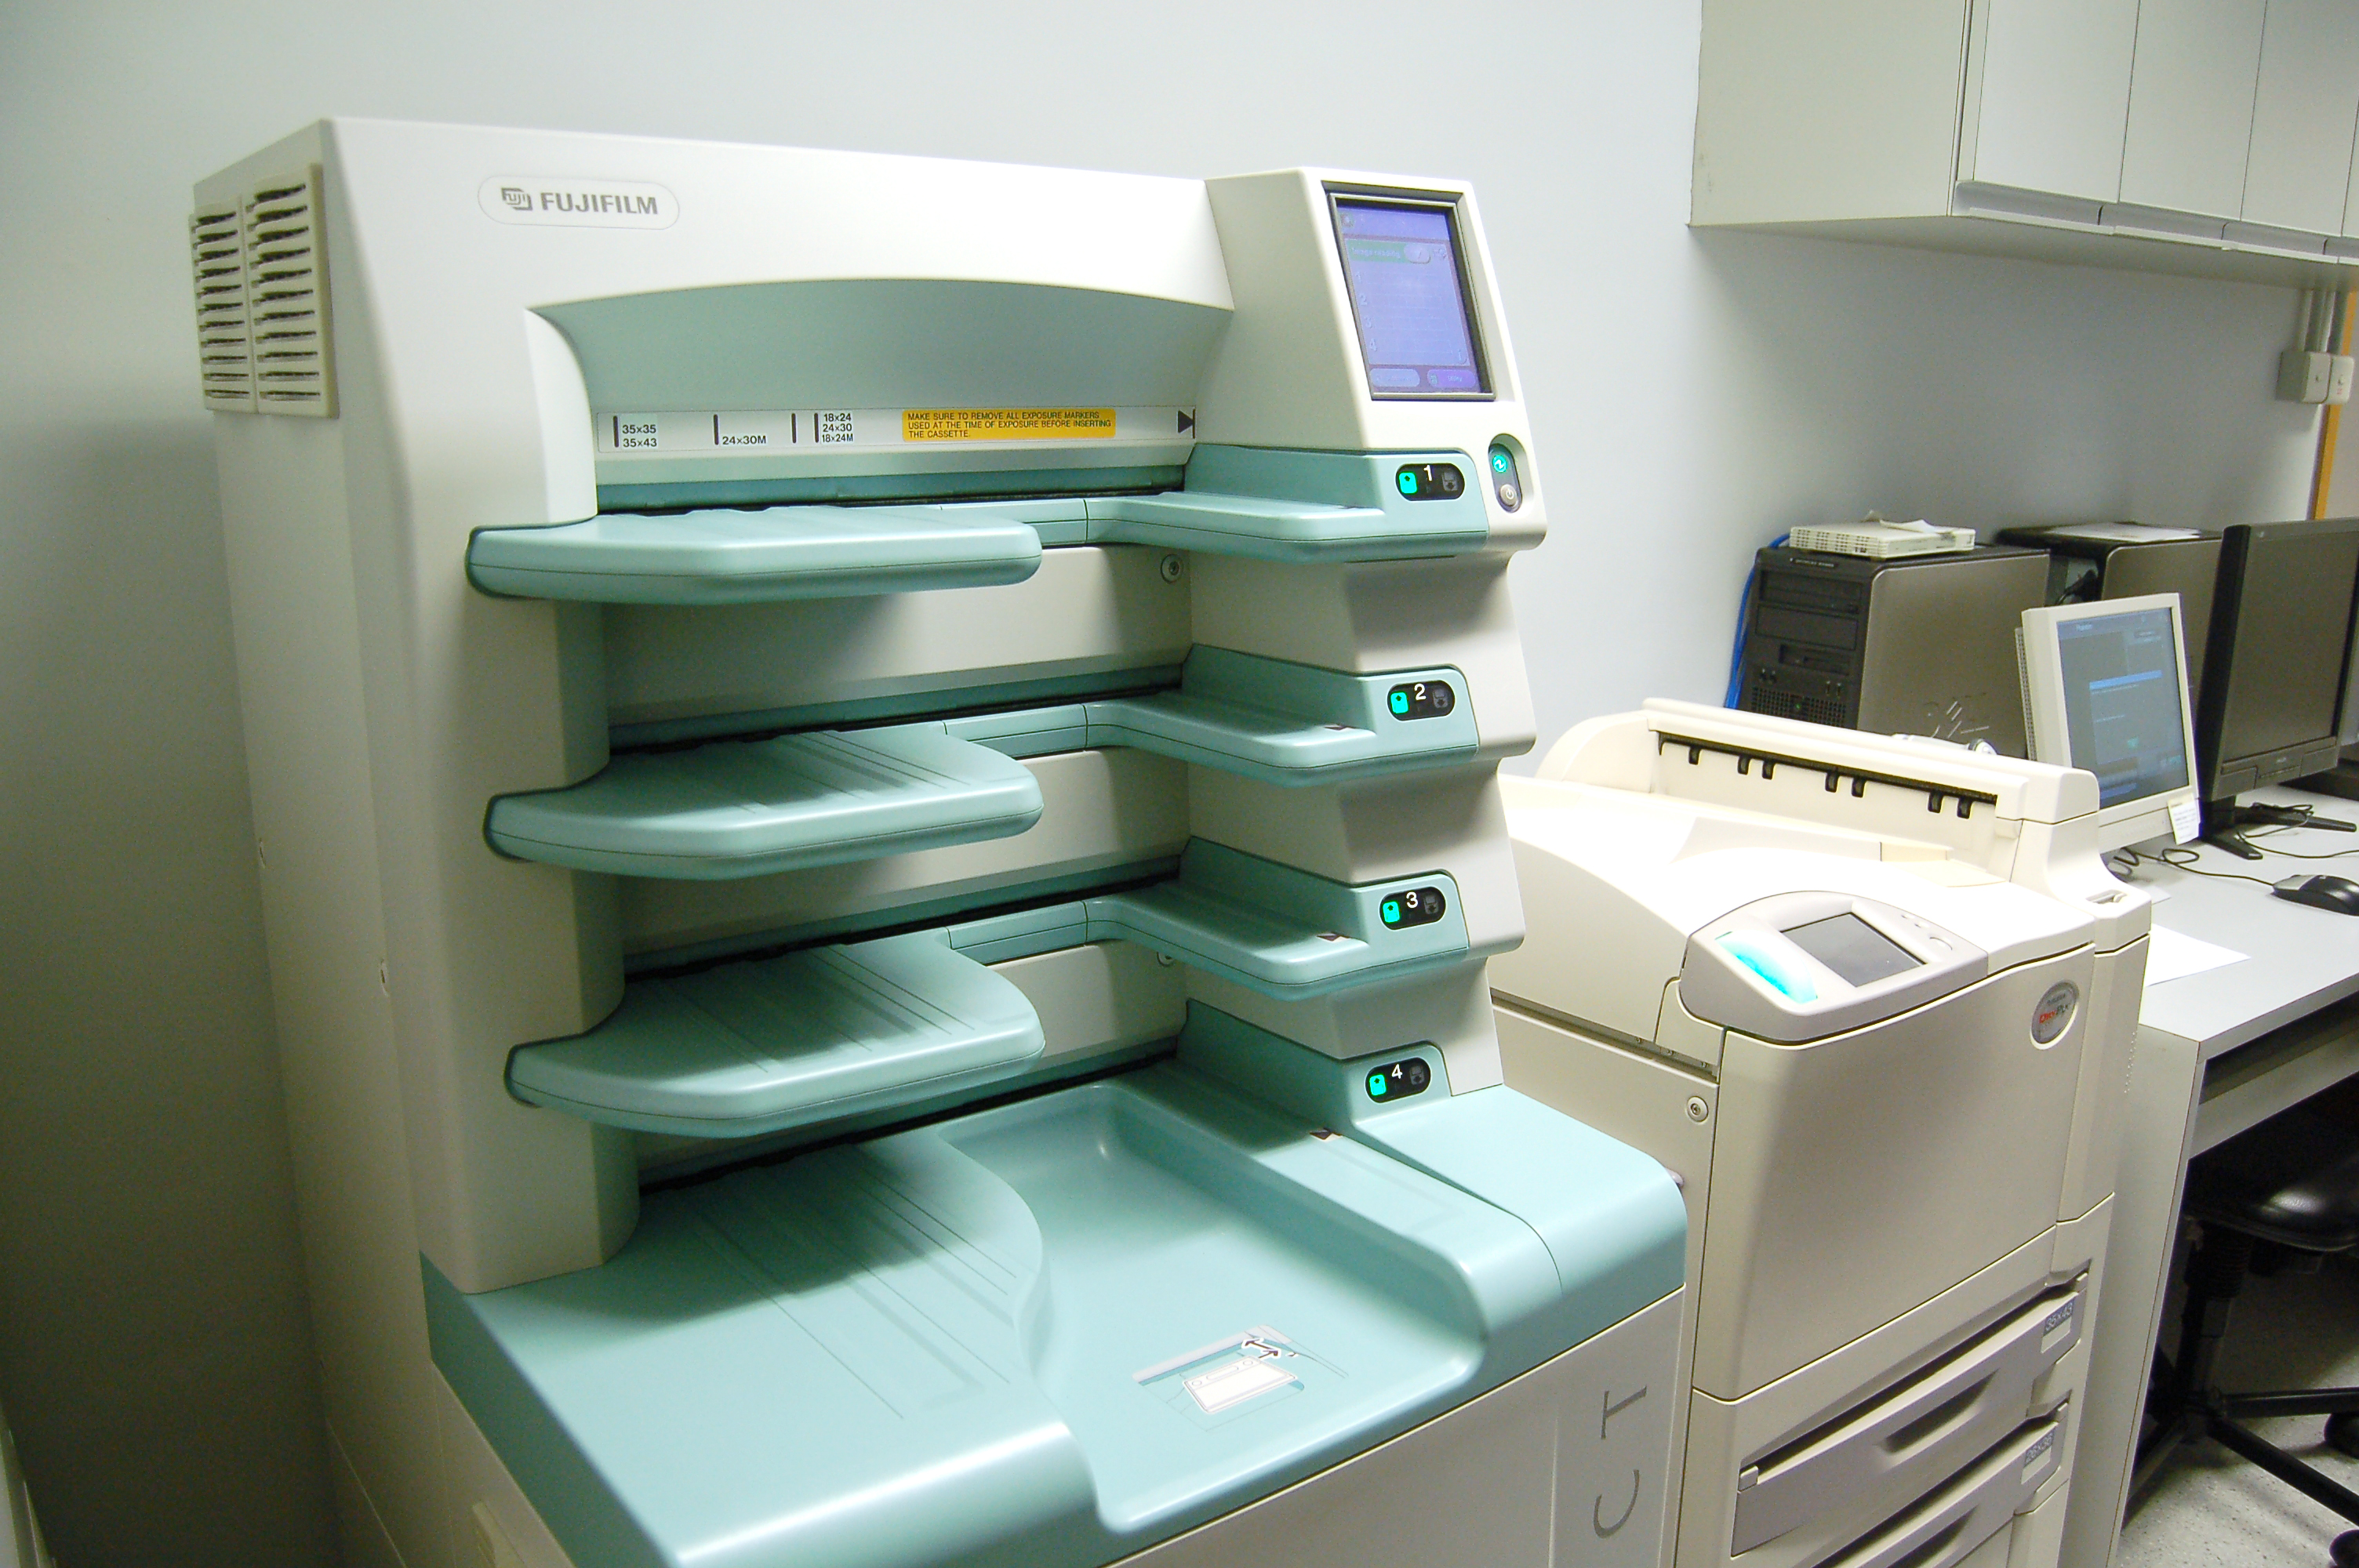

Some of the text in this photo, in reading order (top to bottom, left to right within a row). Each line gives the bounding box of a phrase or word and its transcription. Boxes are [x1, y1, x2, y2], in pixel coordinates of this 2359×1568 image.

[540, 192, 658, 215] FUJIFILM
[958, 412, 969, 420] TO
[1423, 464, 1432, 481] 1
[1414, 683, 1427, 701] 2
[1406, 891, 1419, 909] 3
[1391, 1063, 1403, 1080] 4
